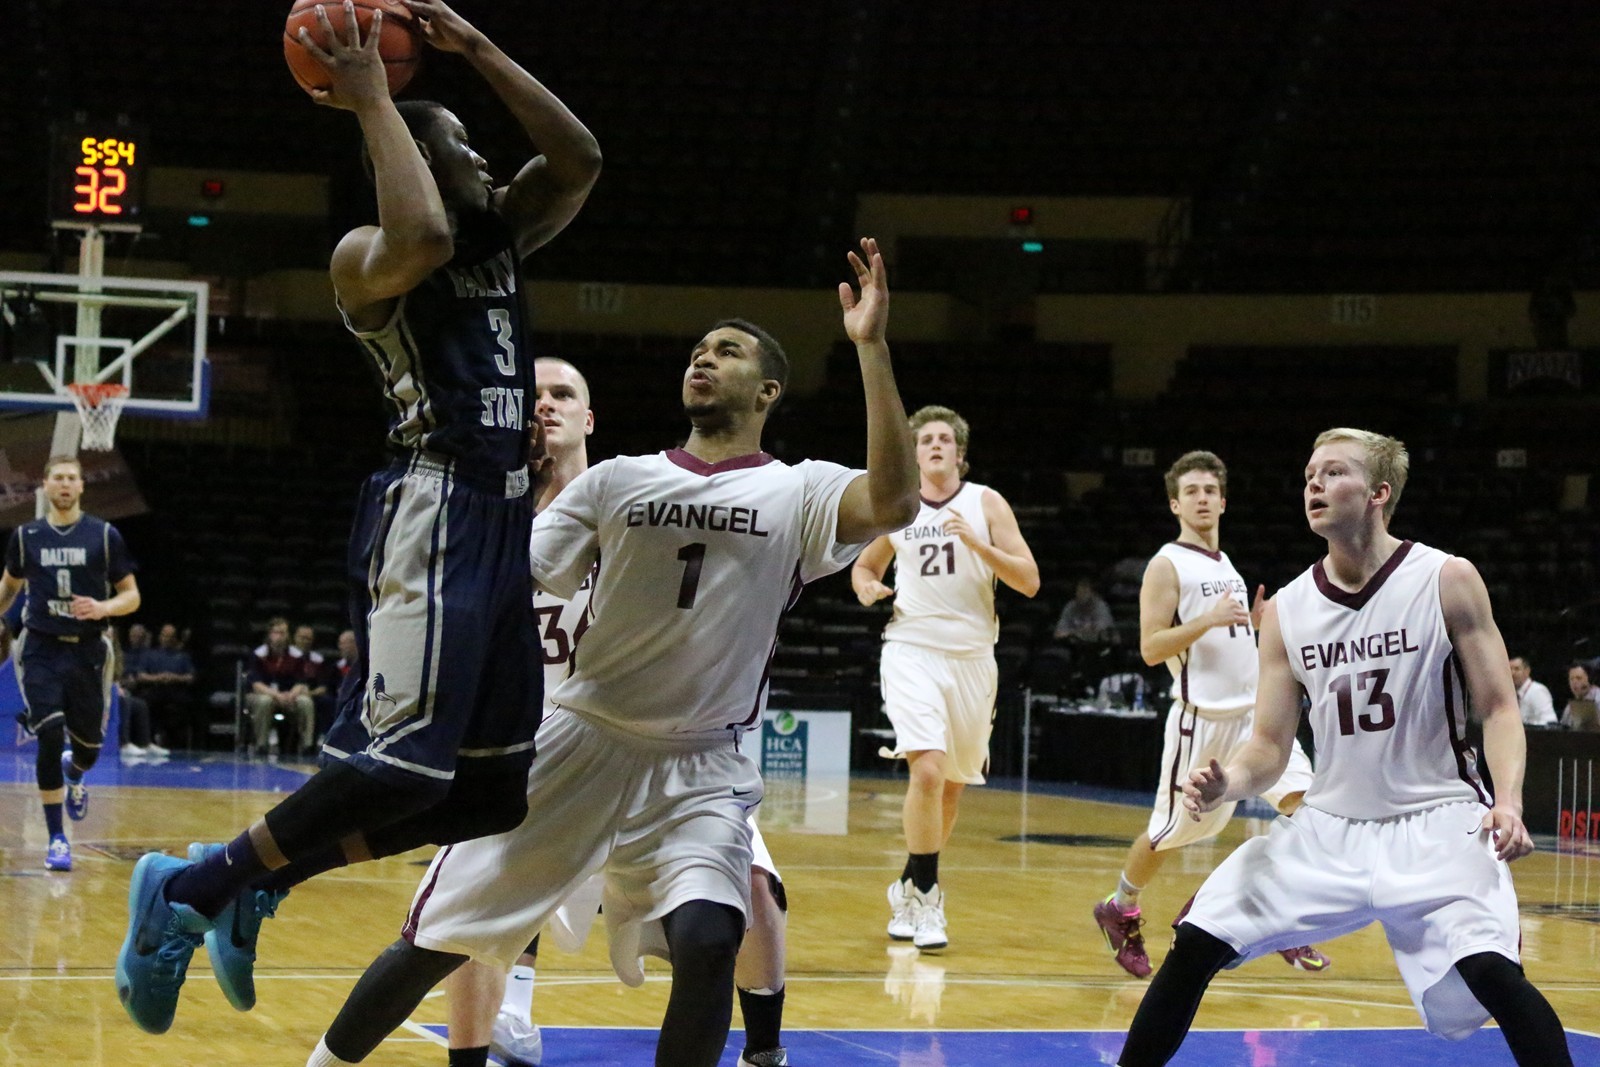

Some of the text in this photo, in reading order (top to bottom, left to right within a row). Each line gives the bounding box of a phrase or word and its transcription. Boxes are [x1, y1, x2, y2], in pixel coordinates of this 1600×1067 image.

[82, 137, 135, 166] 5:54
[74, 166, 126, 214] 32
[487, 308, 516, 376] 3
[481, 387, 524, 431] STAT
[627, 501, 768, 537] EVANGEL
[904, 526, 950, 541] EVAN
[40, 547, 87, 567] DALTON
[919, 541, 955, 577] 21
[56, 568, 71, 598] 0
[677, 542, 706, 609] 1
[1301, 628, 1419, 671] EVANGEL
[1328, 667, 1396, 736] 13
[766, 737, 803, 751] HCA
